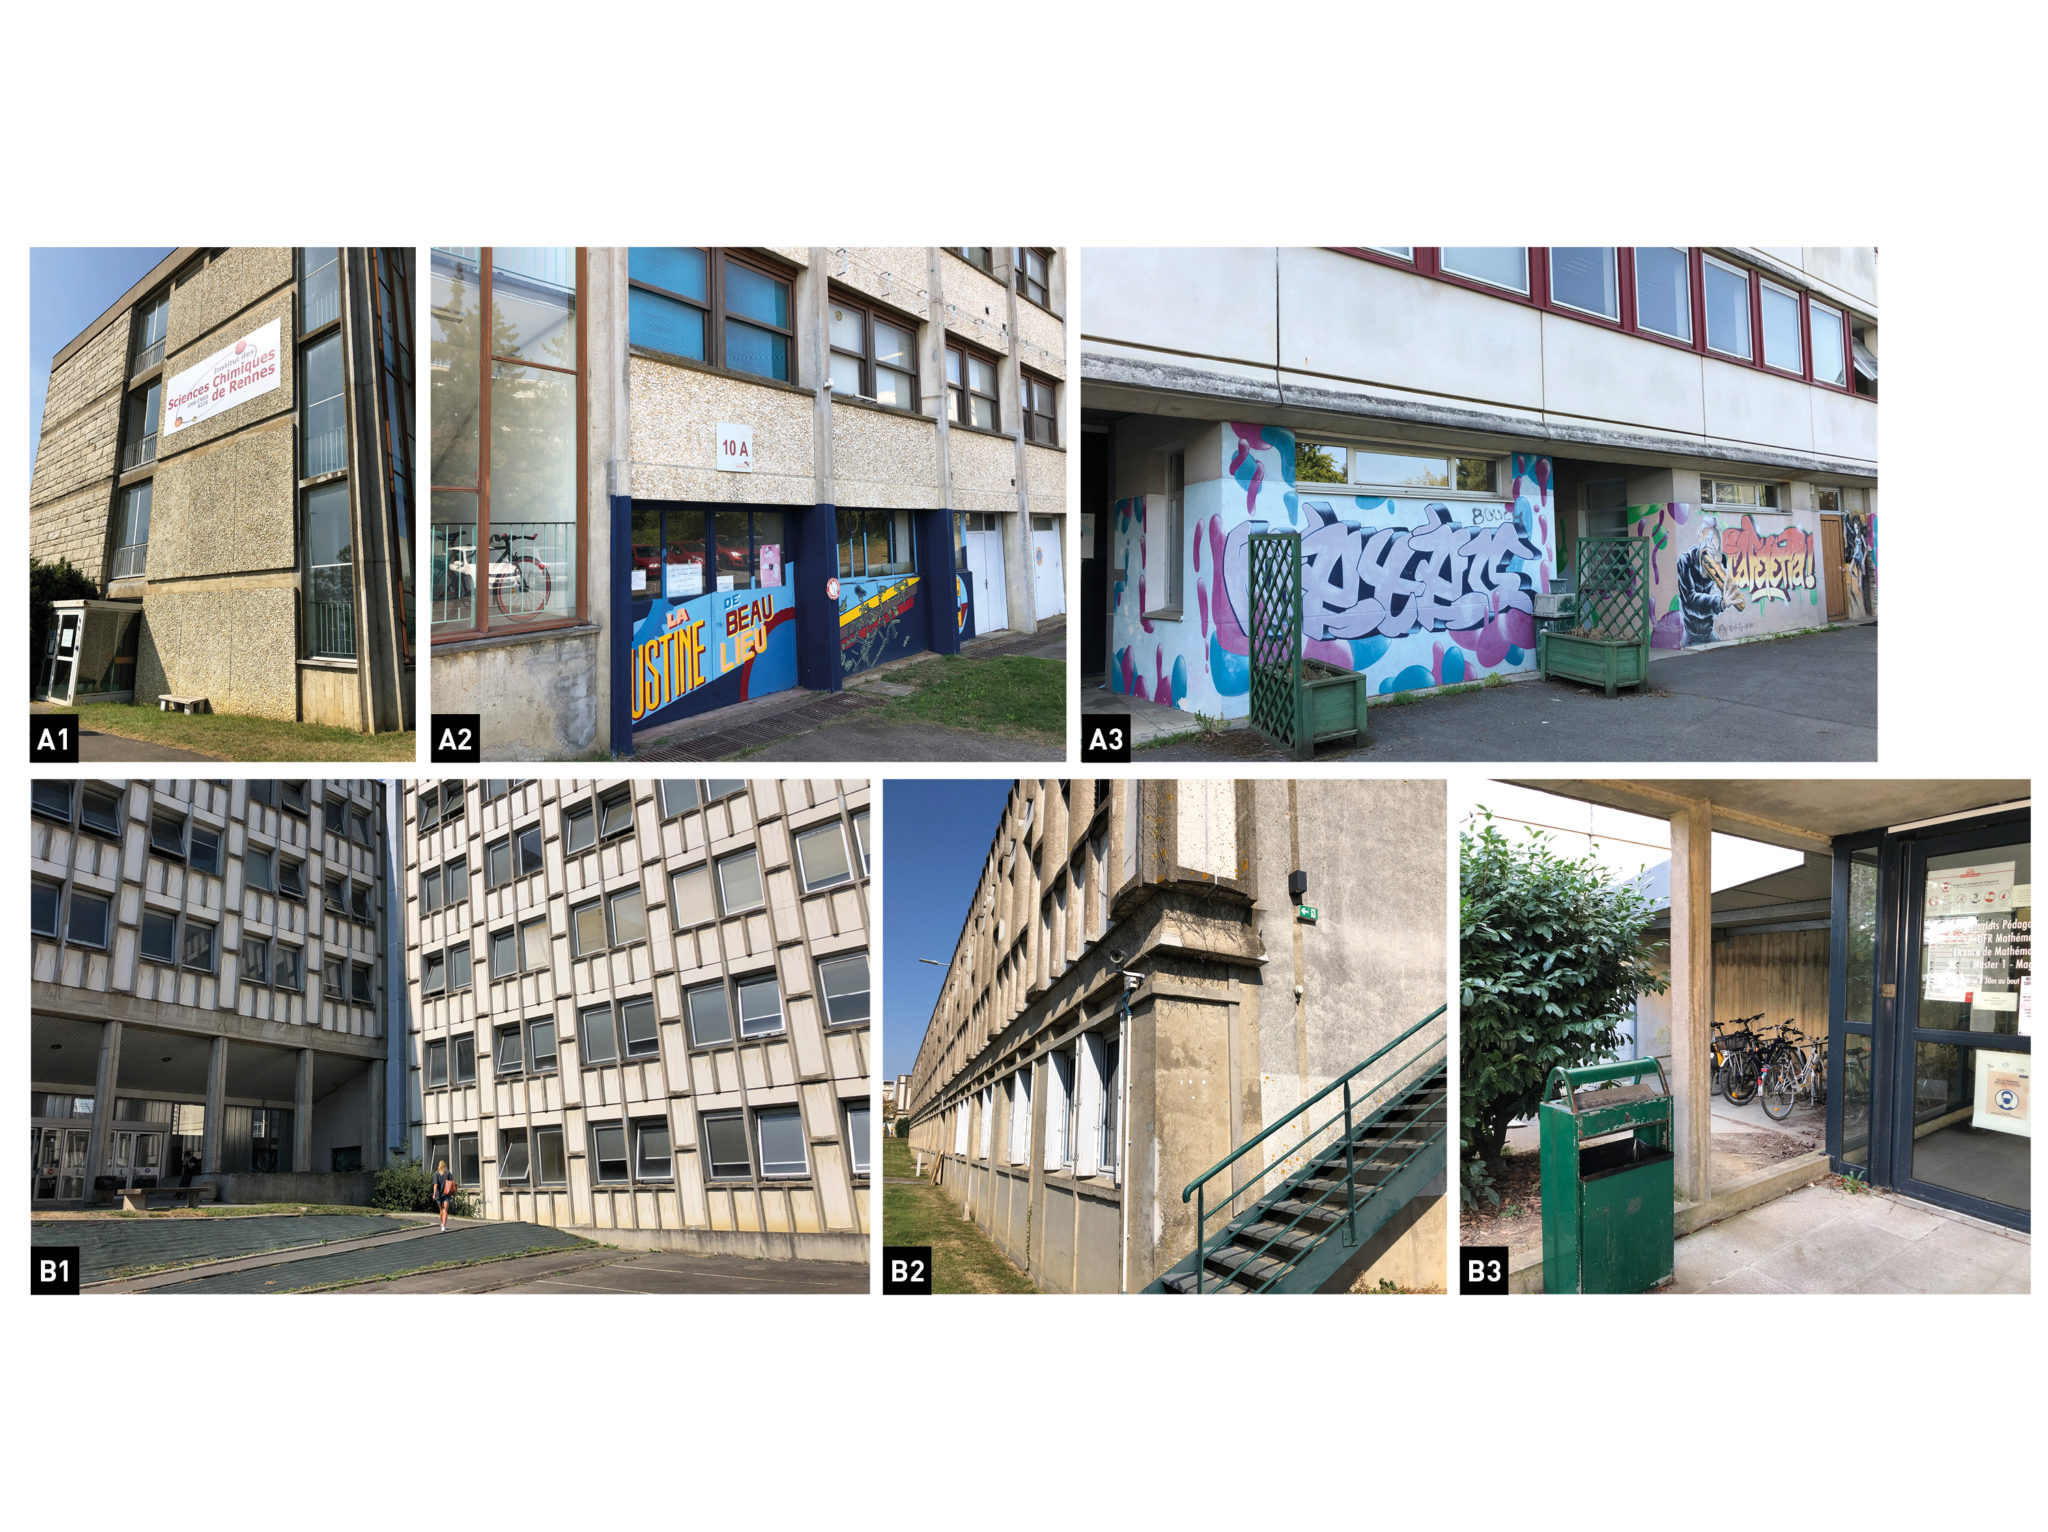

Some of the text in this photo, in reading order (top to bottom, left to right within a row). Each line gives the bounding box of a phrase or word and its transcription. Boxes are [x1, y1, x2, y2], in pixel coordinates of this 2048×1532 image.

[214, 357, 239, 374] Institut
[167, 349, 276, 411] Sciences Chimiques
[211, 363, 276, 402] de Rennes
[722, 439, 749, 457] 10 A
[724, 593, 741, 611] DE
[666, 607, 691, 629] LA
[726, 592, 774, 639] BEAU
[720, 624, 768, 673] LIEU
[1983, 945, 1992, 956] de
[1972, 959, 1999, 969] Master
